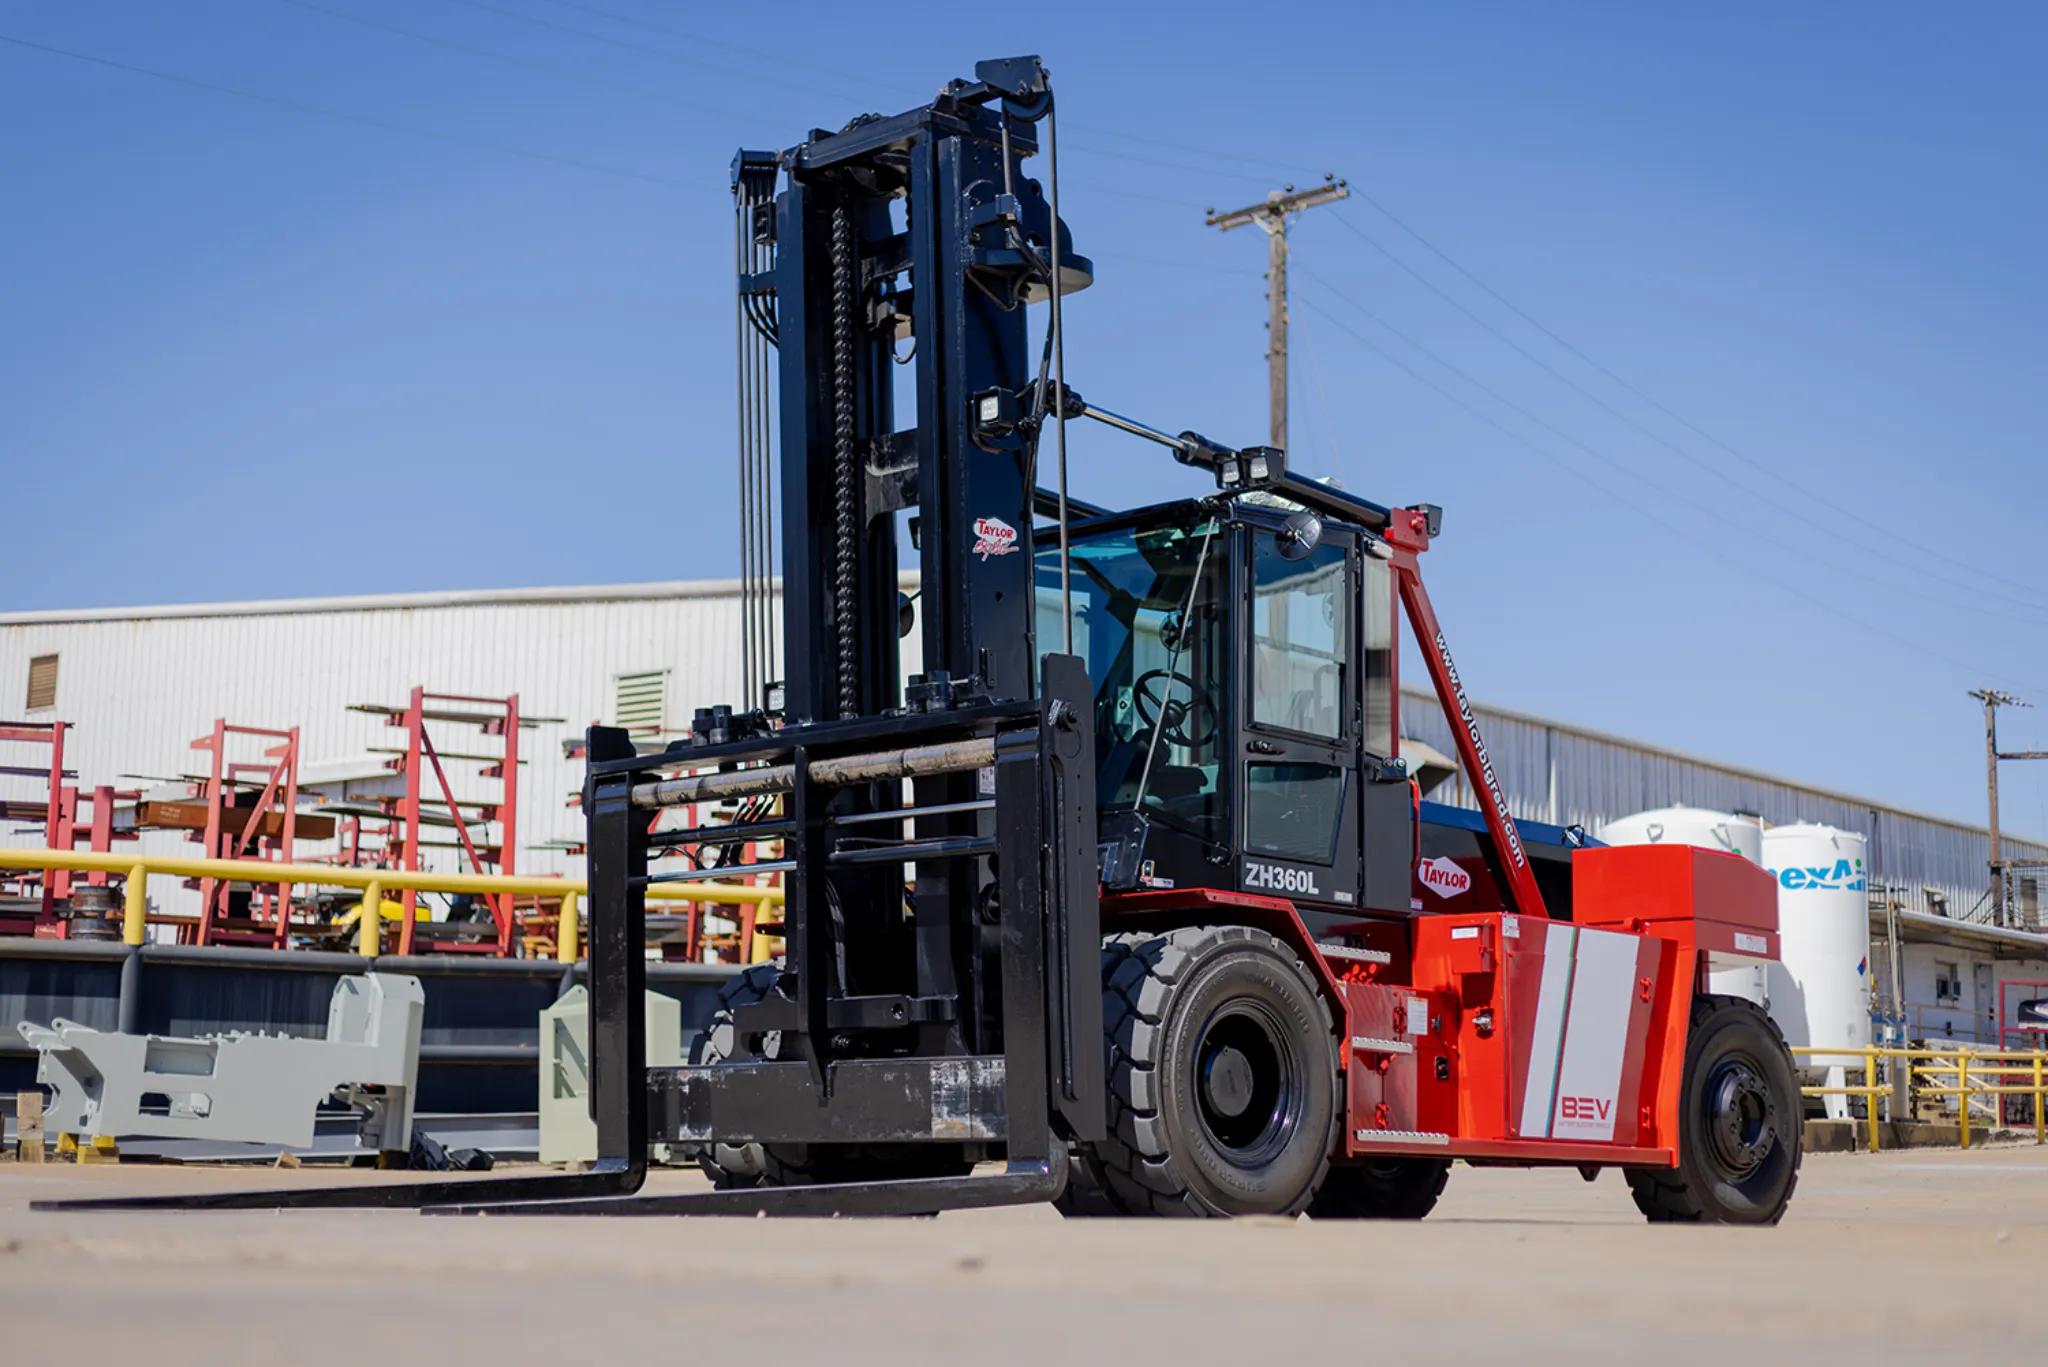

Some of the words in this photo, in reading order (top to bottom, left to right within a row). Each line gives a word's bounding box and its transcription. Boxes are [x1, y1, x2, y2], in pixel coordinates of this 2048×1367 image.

[978, 520, 1013, 539] TAYLOR
[1436, 631, 1525, 868] www.taylorbigred.com
[1245, 862, 1319, 894] ZH360L
[1422, 860, 1468, 889] TAYLOR
[1561, 1096, 1611, 1120] BEV
